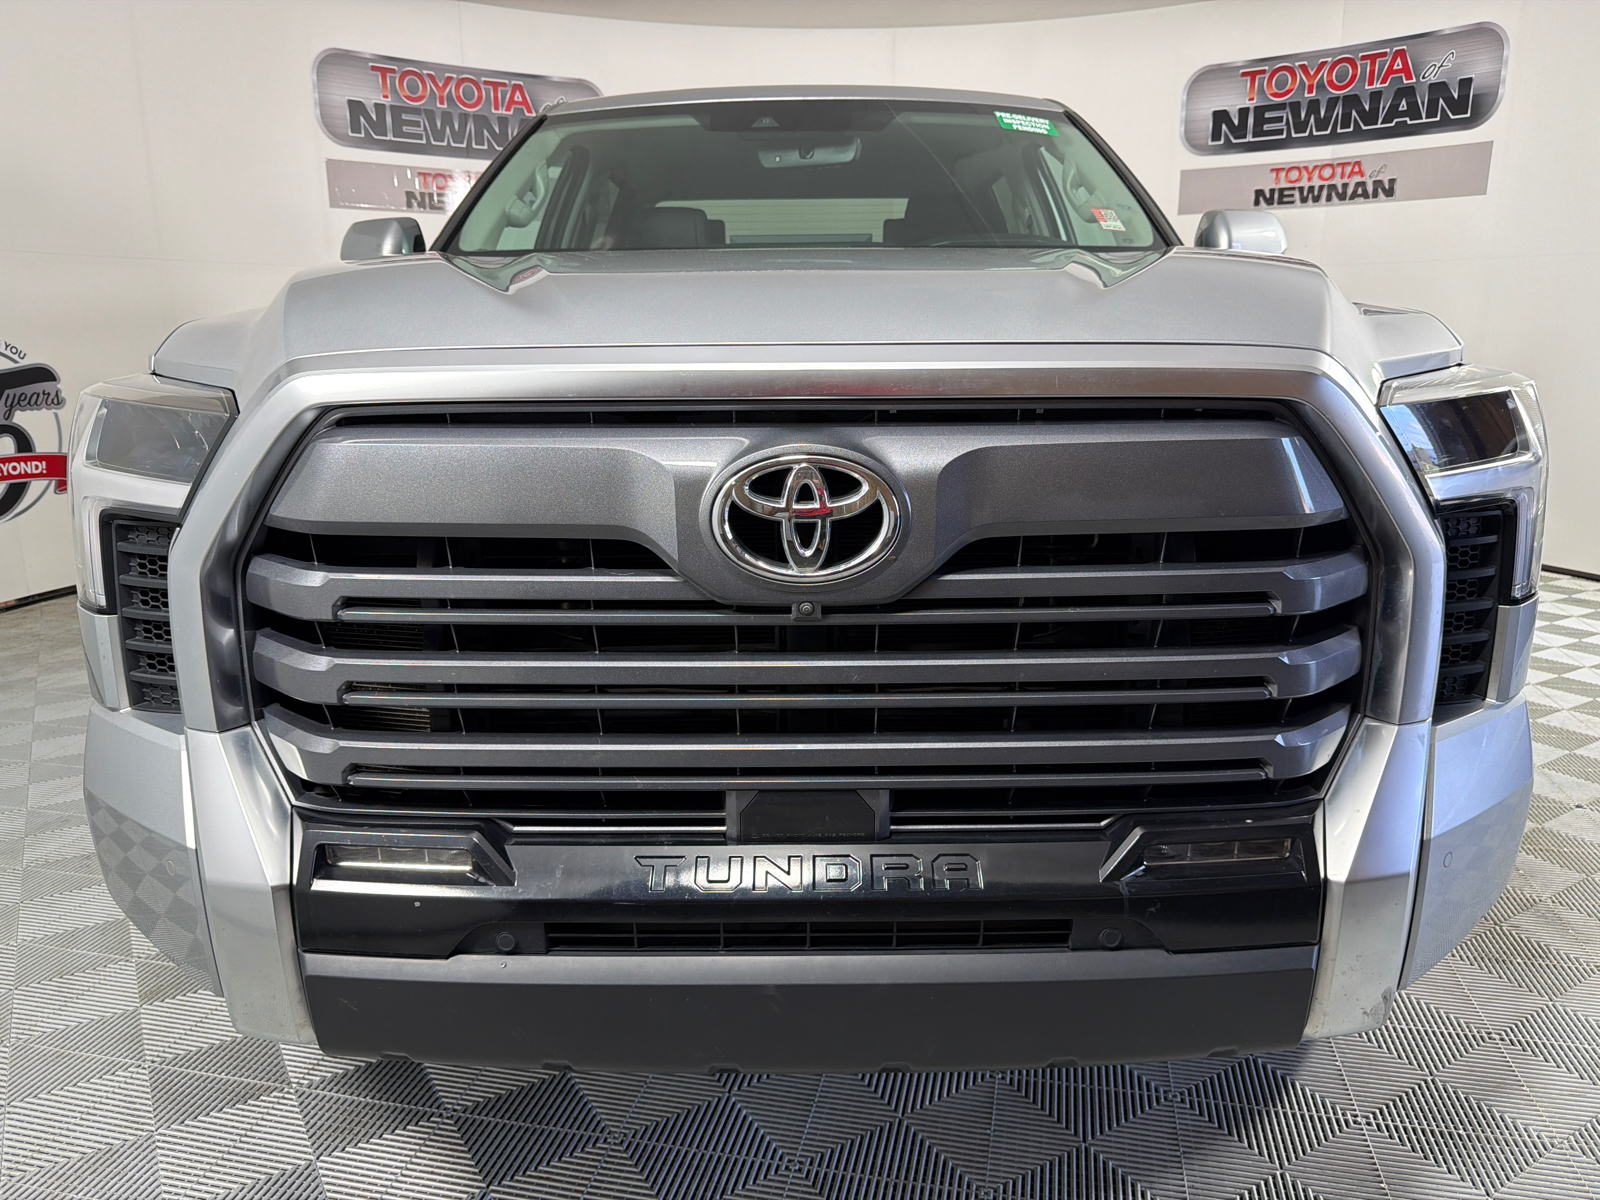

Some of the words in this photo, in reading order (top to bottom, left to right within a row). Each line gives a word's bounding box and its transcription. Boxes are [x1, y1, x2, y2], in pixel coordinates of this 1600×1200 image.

[368, 62, 536, 117] TOYOTA
[1240, 46, 1416, 103] TOYOTA
[1419, 50, 1456, 82] of
[346, 98, 535, 150] NEWN
[1208, 74, 1475, 146] NEWNAN
[1012, 124, 1048, 135] PENDING
[1269, 160, 1366, 186] TOYOTA
[1253, 177, 1396, 207] NEWNAN
[4, 340, 27, 360] YOU
[3, 389, 64, 421] years
[0, 461, 47, 476] YOND!
[633, 853, 984, 894] TUNDRA
